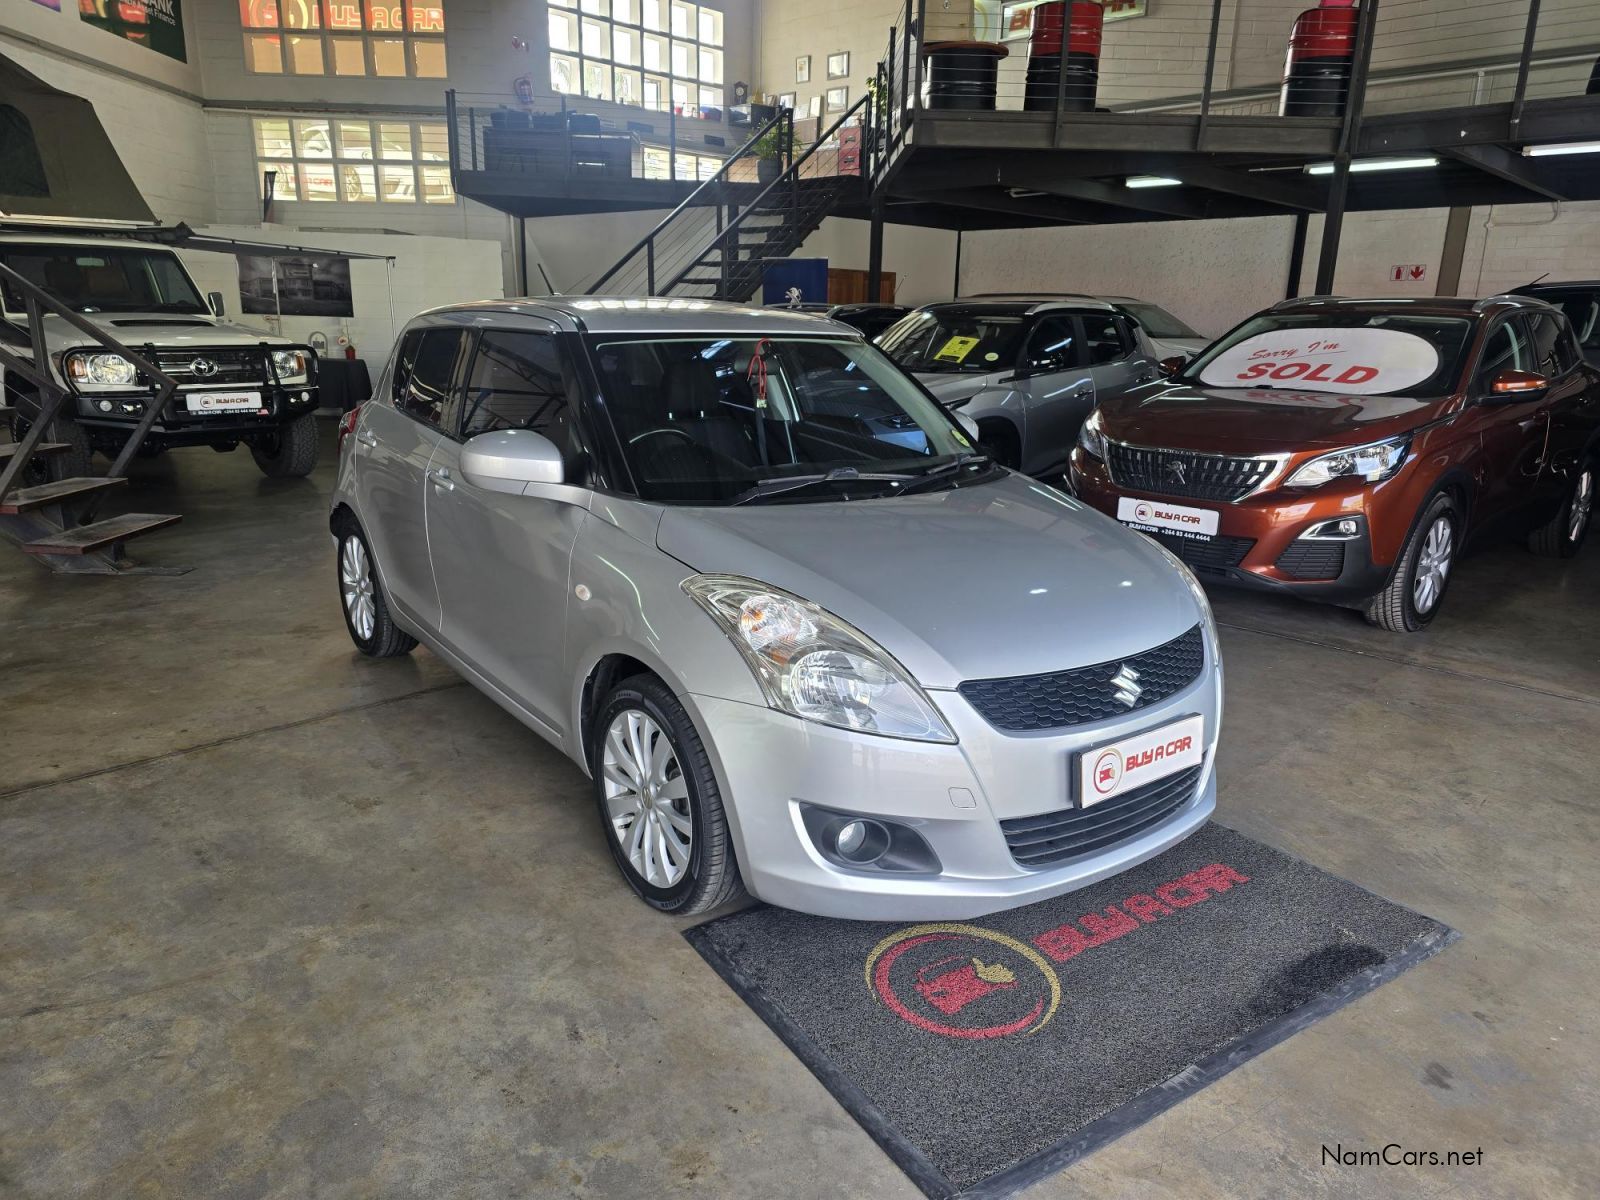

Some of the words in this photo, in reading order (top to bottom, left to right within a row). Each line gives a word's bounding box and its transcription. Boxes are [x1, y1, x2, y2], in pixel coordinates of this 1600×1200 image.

[371, 6, 389, 29] A
[391, 7, 444, 30] CAR
[1247, 349, 1298, 361] Sorry
[1308, 340, 1340, 352] I'm
[1236, 362, 1379, 384] SOLD
[1154, 511, 1173, 520] BUY
[1181, 515, 1201, 525] CAR
[1125, 748, 1154, 772] BUY
[1155, 745, 1165, 761] A
[1165, 735, 1192, 757] CAR
